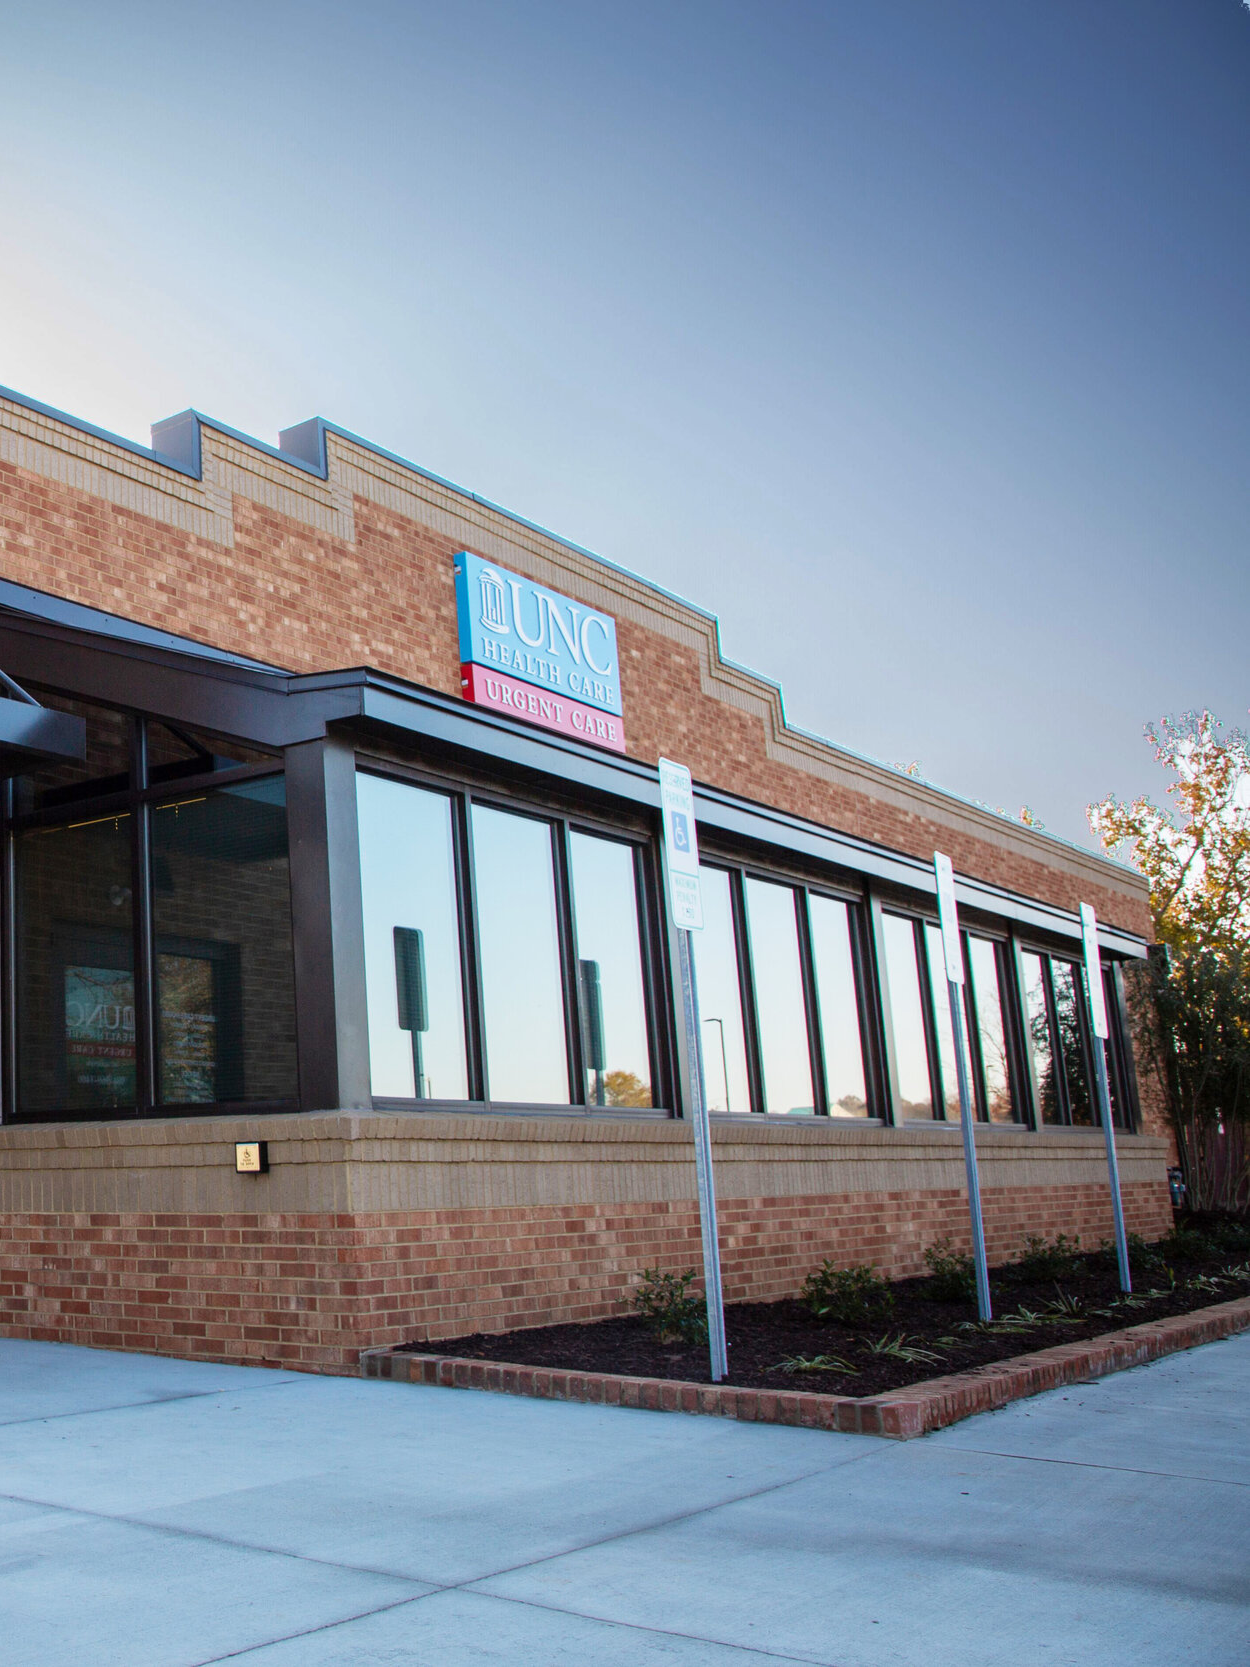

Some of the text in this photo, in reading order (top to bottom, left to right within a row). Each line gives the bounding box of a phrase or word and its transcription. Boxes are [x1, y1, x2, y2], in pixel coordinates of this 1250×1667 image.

[505, 579, 612, 677] UNC
[481, 636, 615, 706] HEALTH CARE
[484, 678, 618, 743] URGENT CARE
